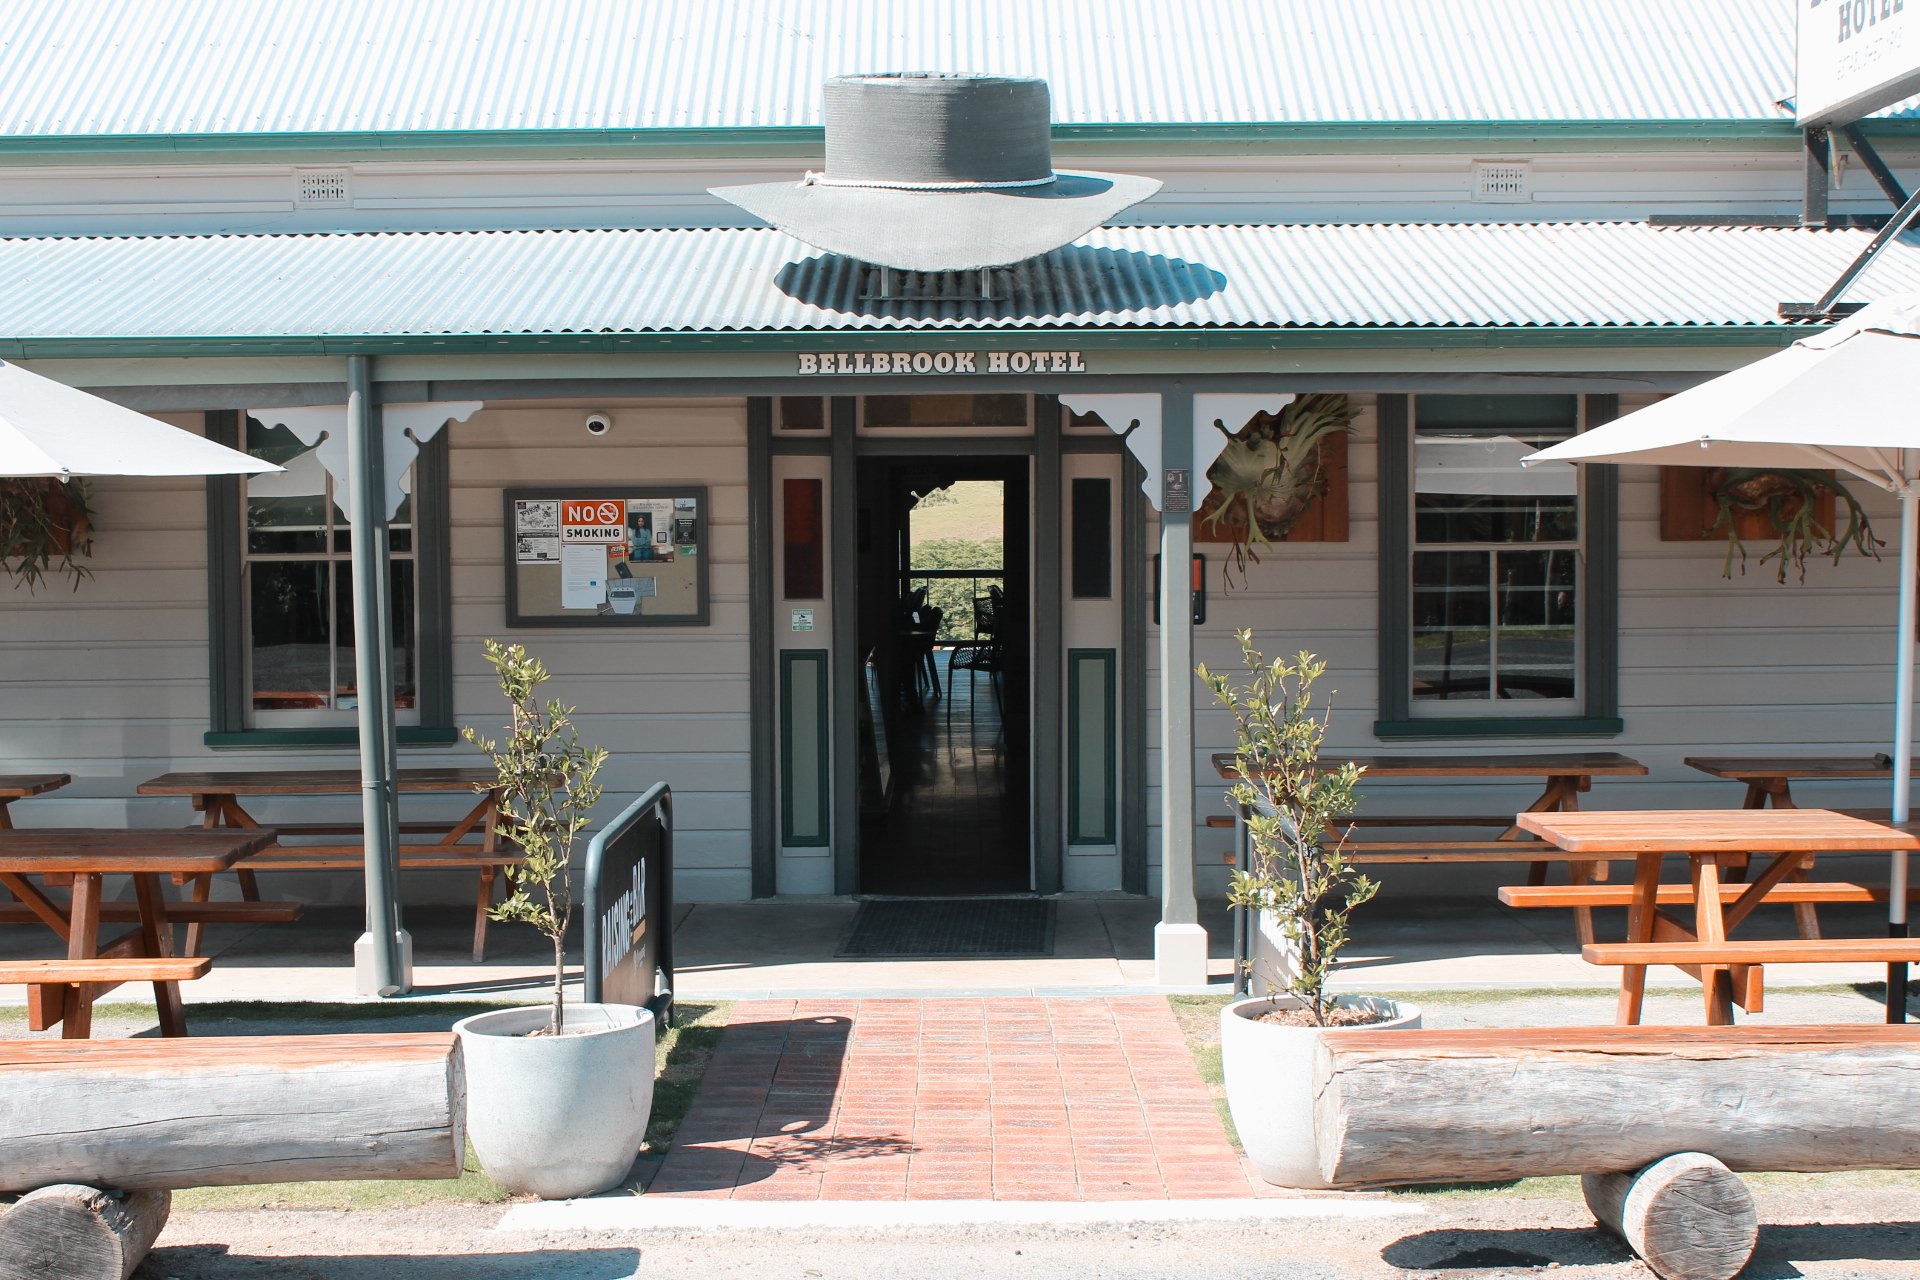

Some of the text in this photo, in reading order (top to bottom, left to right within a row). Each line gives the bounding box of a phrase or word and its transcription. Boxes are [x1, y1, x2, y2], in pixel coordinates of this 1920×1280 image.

[798, 351, 1085, 374] BELLBROOK HOTEL
[568, 505, 595, 522] NO
[566, 528, 620, 538] SMOKING
[602, 889, 630, 982] RAISING
[632, 857, 646, 927] BAR
